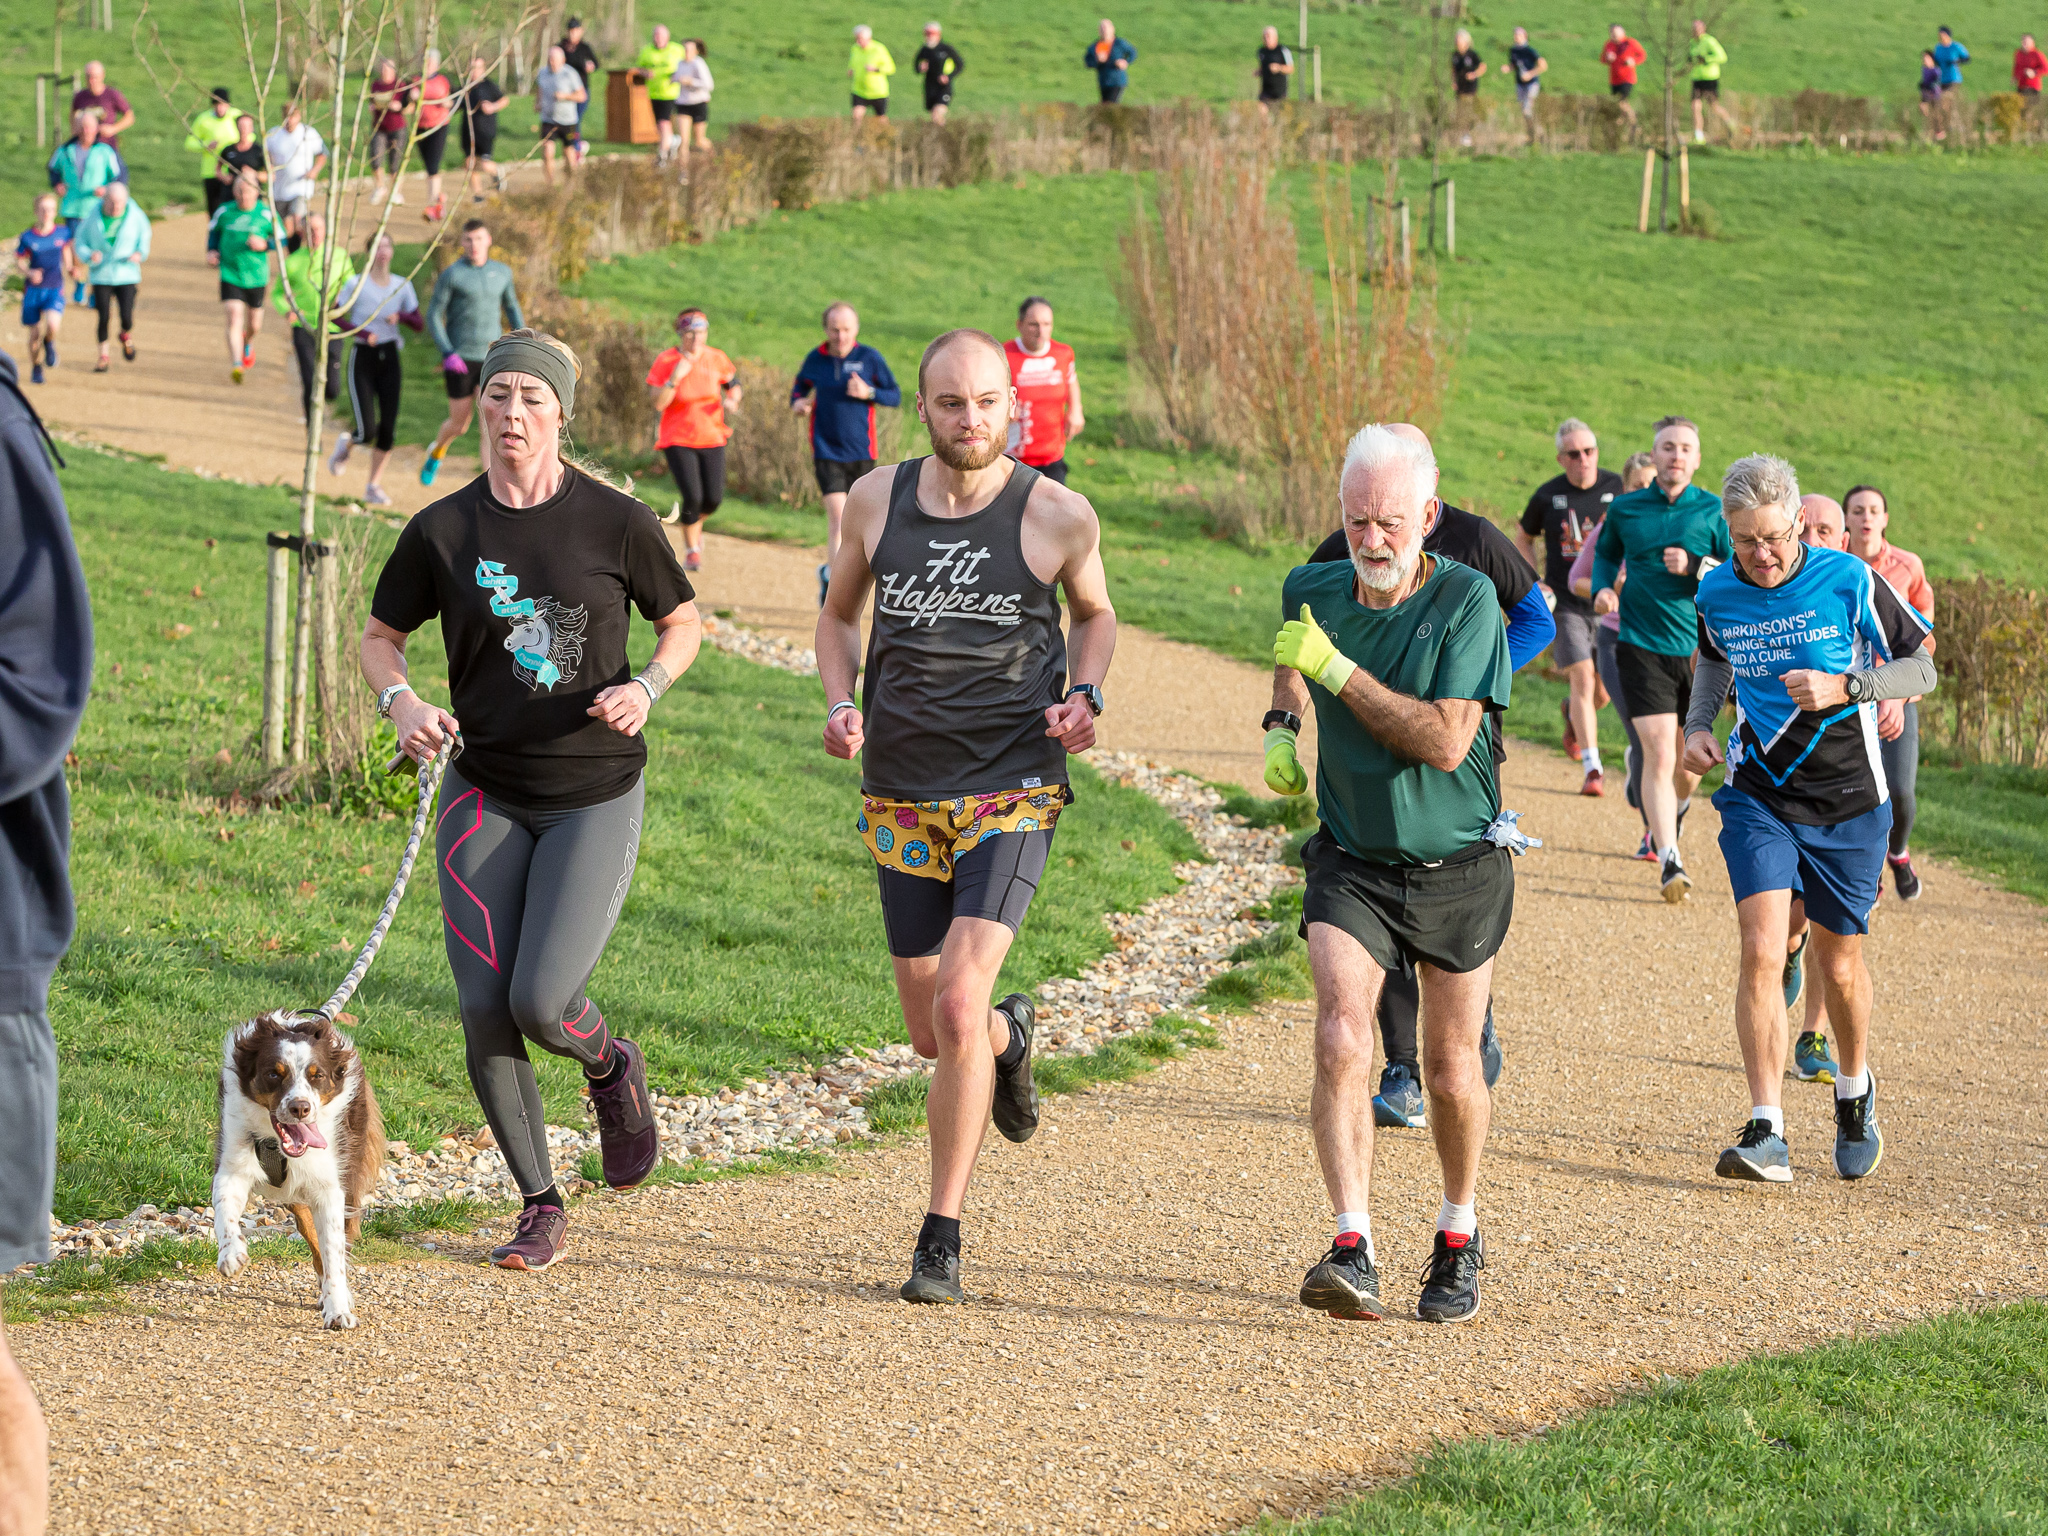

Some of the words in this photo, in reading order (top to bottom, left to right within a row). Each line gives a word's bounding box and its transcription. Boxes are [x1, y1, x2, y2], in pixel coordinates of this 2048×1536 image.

[926, 540, 991, 585] Fit
[482, 577, 508, 585] white
[881, 572, 1022, 627] Happens.
[501, 604, 522, 614] star
[1769, 625, 1842, 649] ATTITUDES.
[518, 652, 550, 672] running
[1749, 652, 1758, 665] A
[1758, 648, 1796, 664] CURE.
[1751, 665, 1772, 678] US.
